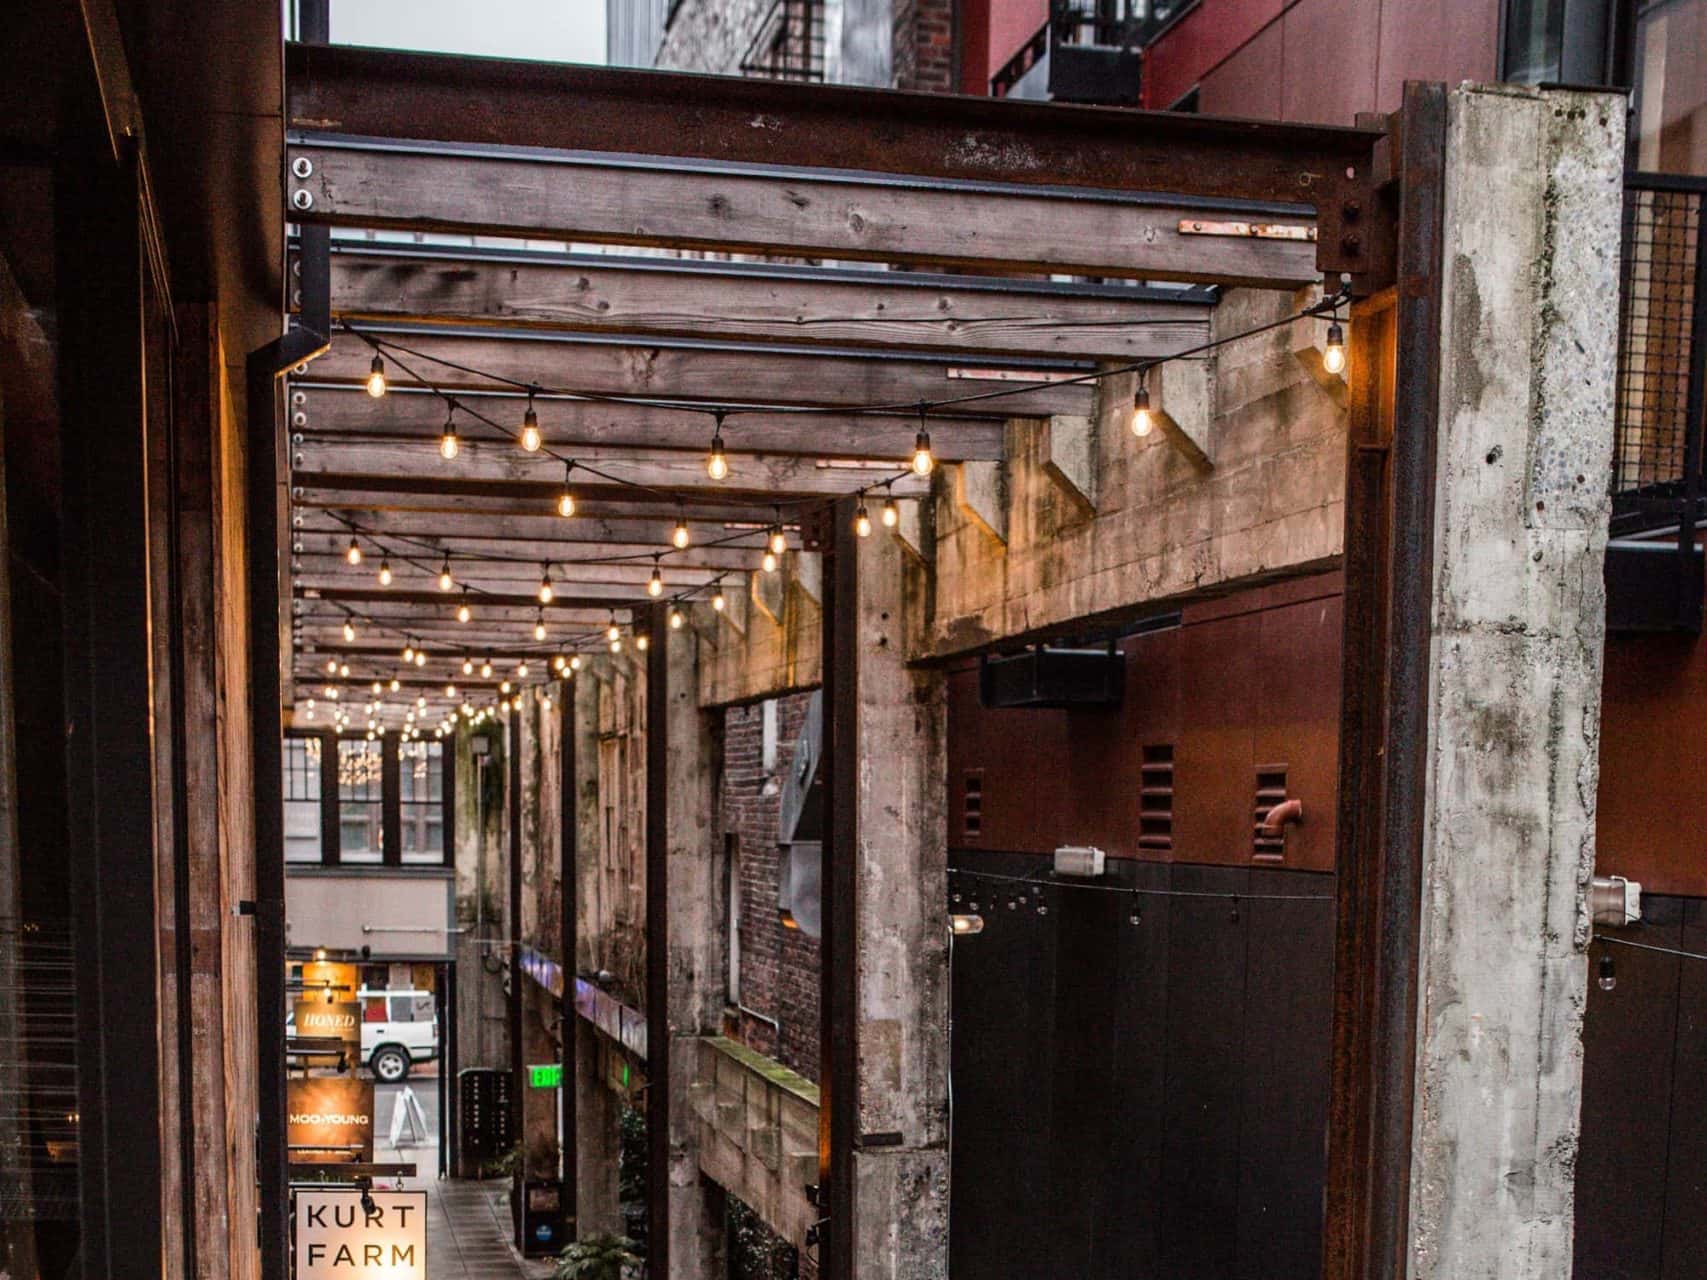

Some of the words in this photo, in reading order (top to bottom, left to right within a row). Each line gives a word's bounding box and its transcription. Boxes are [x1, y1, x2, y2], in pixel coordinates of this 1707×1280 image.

[303, 1012, 355, 1027] HONED
[307, 1204, 415, 1228] KURT
[307, 1243, 415, 1267] FARM
